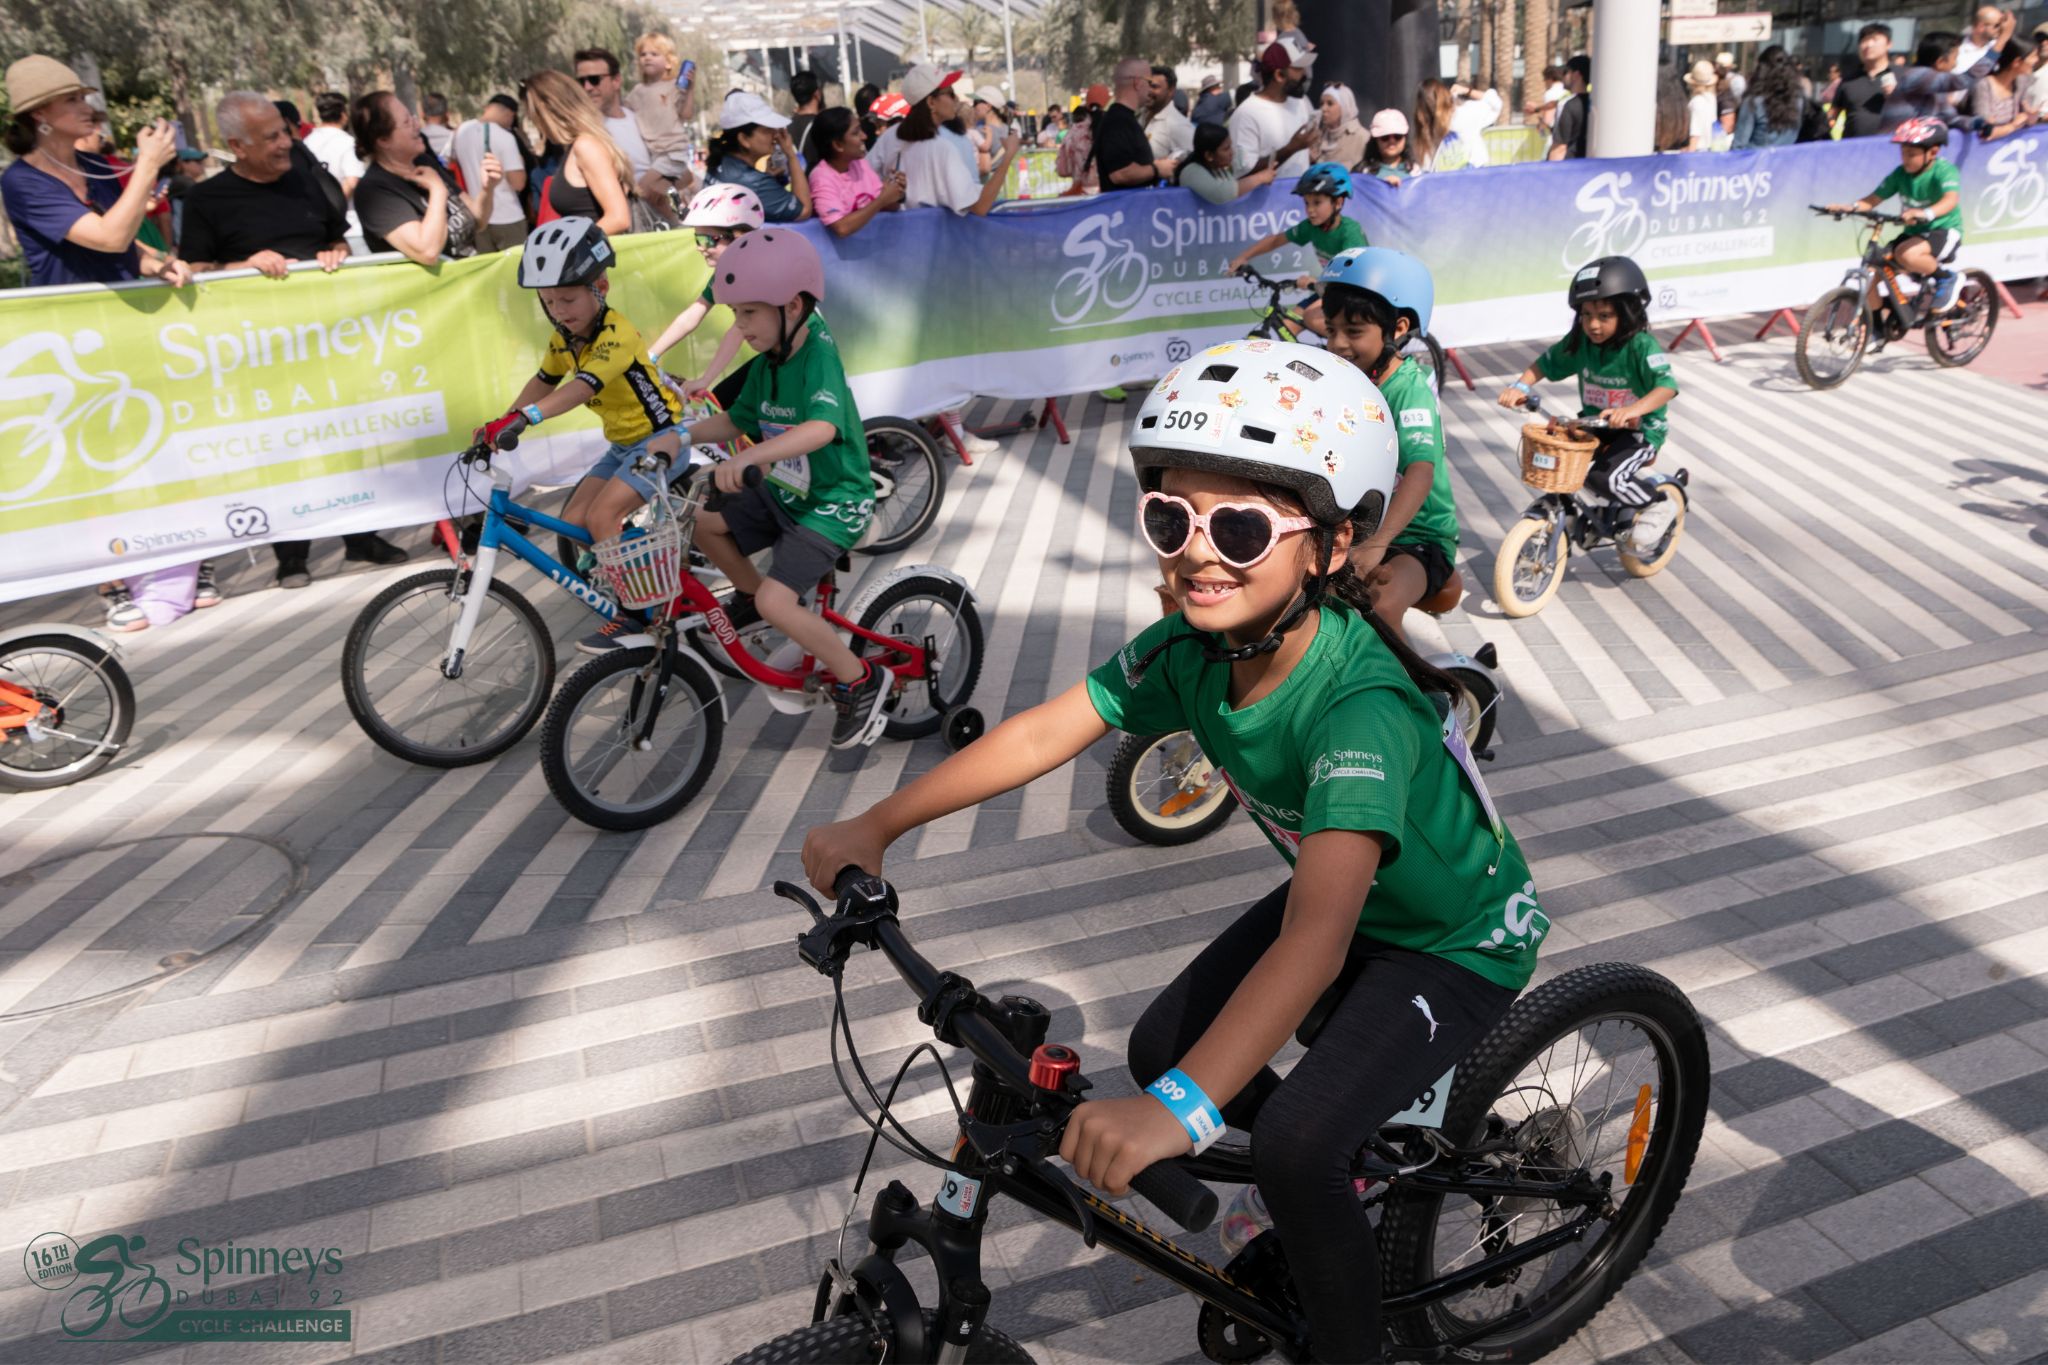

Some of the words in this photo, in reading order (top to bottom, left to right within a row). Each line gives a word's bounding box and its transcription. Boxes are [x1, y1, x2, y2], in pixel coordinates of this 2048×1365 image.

[1651, 170, 1772, 215] Spinneys
[1151, 207, 1301, 257] Spinneys
[1650, 212, 1723, 234] DUBAI
[1742, 208, 1768, 225] 92
[1651, 244, 1691, 259] CYCLE
[1695, 235, 1768, 255] CHALLENGE
[1152, 258, 1231, 281] DUBA
[1270, 250, 1303, 270] 92
[1153, 290, 1203, 308] CYCLE
[158, 308, 424, 389] Spinneys
[1167, 341, 1192, 363] 92
[172, 378, 339, 425] DUBAI
[380, 364, 429, 392] 92
[1164, 410, 1208, 431] 509
[186, 432, 273, 464] CYCLE
[283, 405, 435, 449] CHALLENGE
[226, 506, 270, 538] 92
[132, 526, 207, 551] Spinneys
[1333, 749, 1383, 763] Spinneys
[1154, 1076, 1186, 1101] 509
